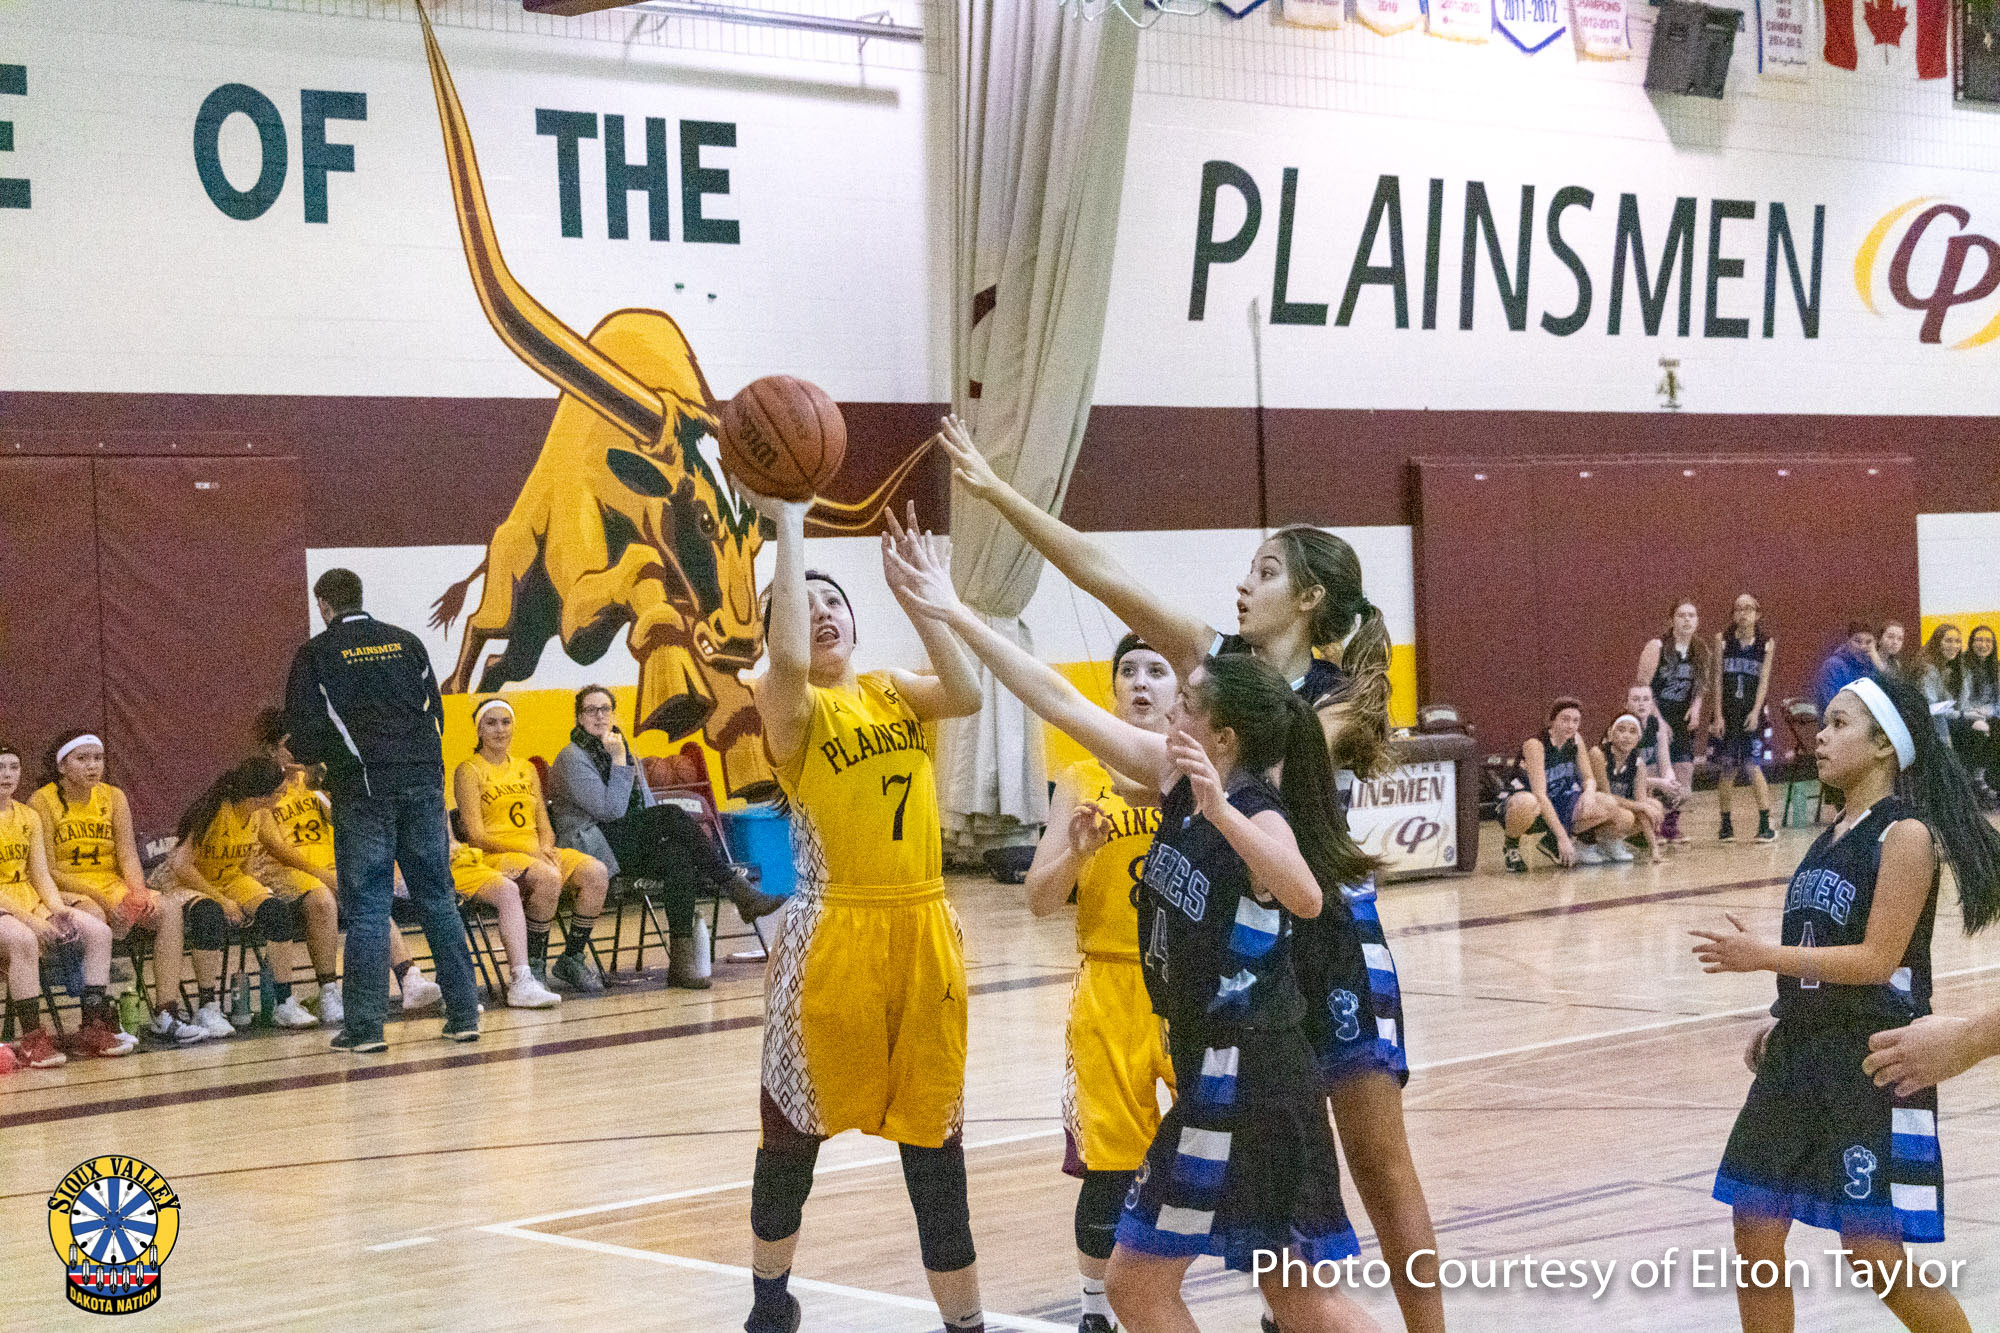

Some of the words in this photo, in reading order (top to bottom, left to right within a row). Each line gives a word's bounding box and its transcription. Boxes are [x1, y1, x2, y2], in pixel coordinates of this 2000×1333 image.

[1504, 0, 1559, 24] 2011-2012
[193, 82, 368, 225] OF
[535, 107, 741, 245] THE
[1188, 160, 1826, 339] PLAINSMEN
[341, 642, 402, 659] PLAINSMEN
[1348, 776, 1446, 810] INSMEN
[509, 801, 526, 828] 6
[882, 772, 912, 842] 7
[293, 819, 322, 843] 13
